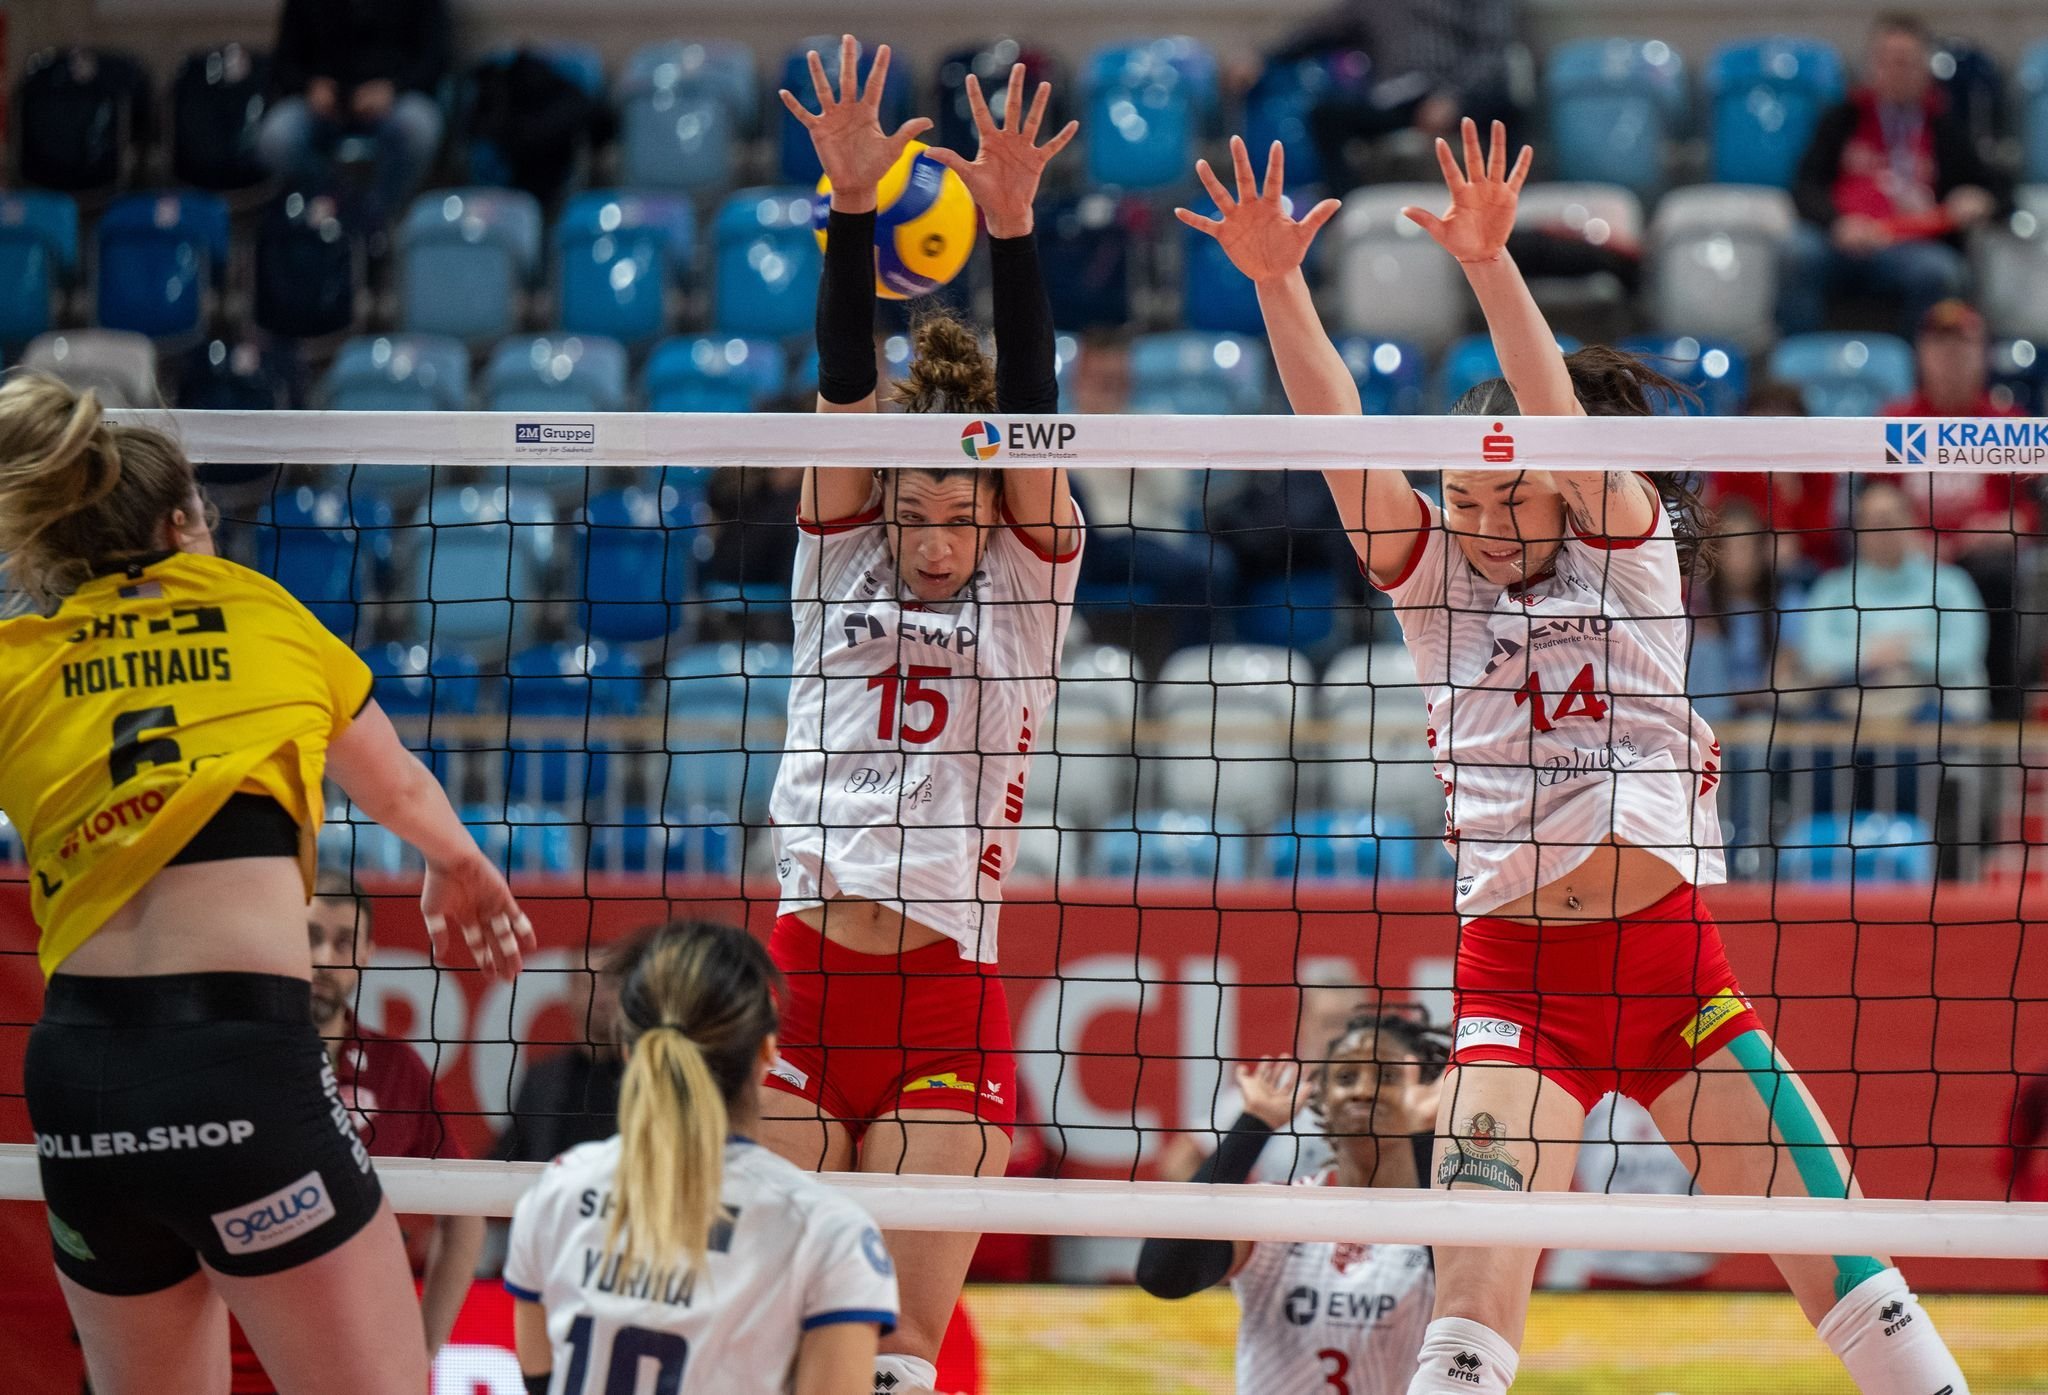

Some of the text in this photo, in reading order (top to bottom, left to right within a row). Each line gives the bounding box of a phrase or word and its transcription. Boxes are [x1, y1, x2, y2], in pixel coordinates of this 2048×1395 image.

[517, 427, 592, 441] 2M Gruppe
[1008, 423, 1076, 450] EWP
[1938, 448, 2046, 465] BAUGRUP
[1533, 634, 1581, 651] Stadtwerke
[62, 648, 231, 698] HOLTHAUS
[866, 663, 952, 745] 15
[1513, 662, 1609, 734] 14
[109, 704, 182, 791] 6
[81, 789, 166, 843] LOTTO
[1457, 1021, 1493, 1041] AOK
[34, 1119, 255, 1159] OLLER.SHOP
[1464, 1147, 1499, 1159] Dresdner
[225, 1185, 320, 1245] gewo
[1327, 1292, 1396, 1319] EWP
[564, 1313, 690, 1395] 10
[1317, 1348, 1349, 1395] 3
